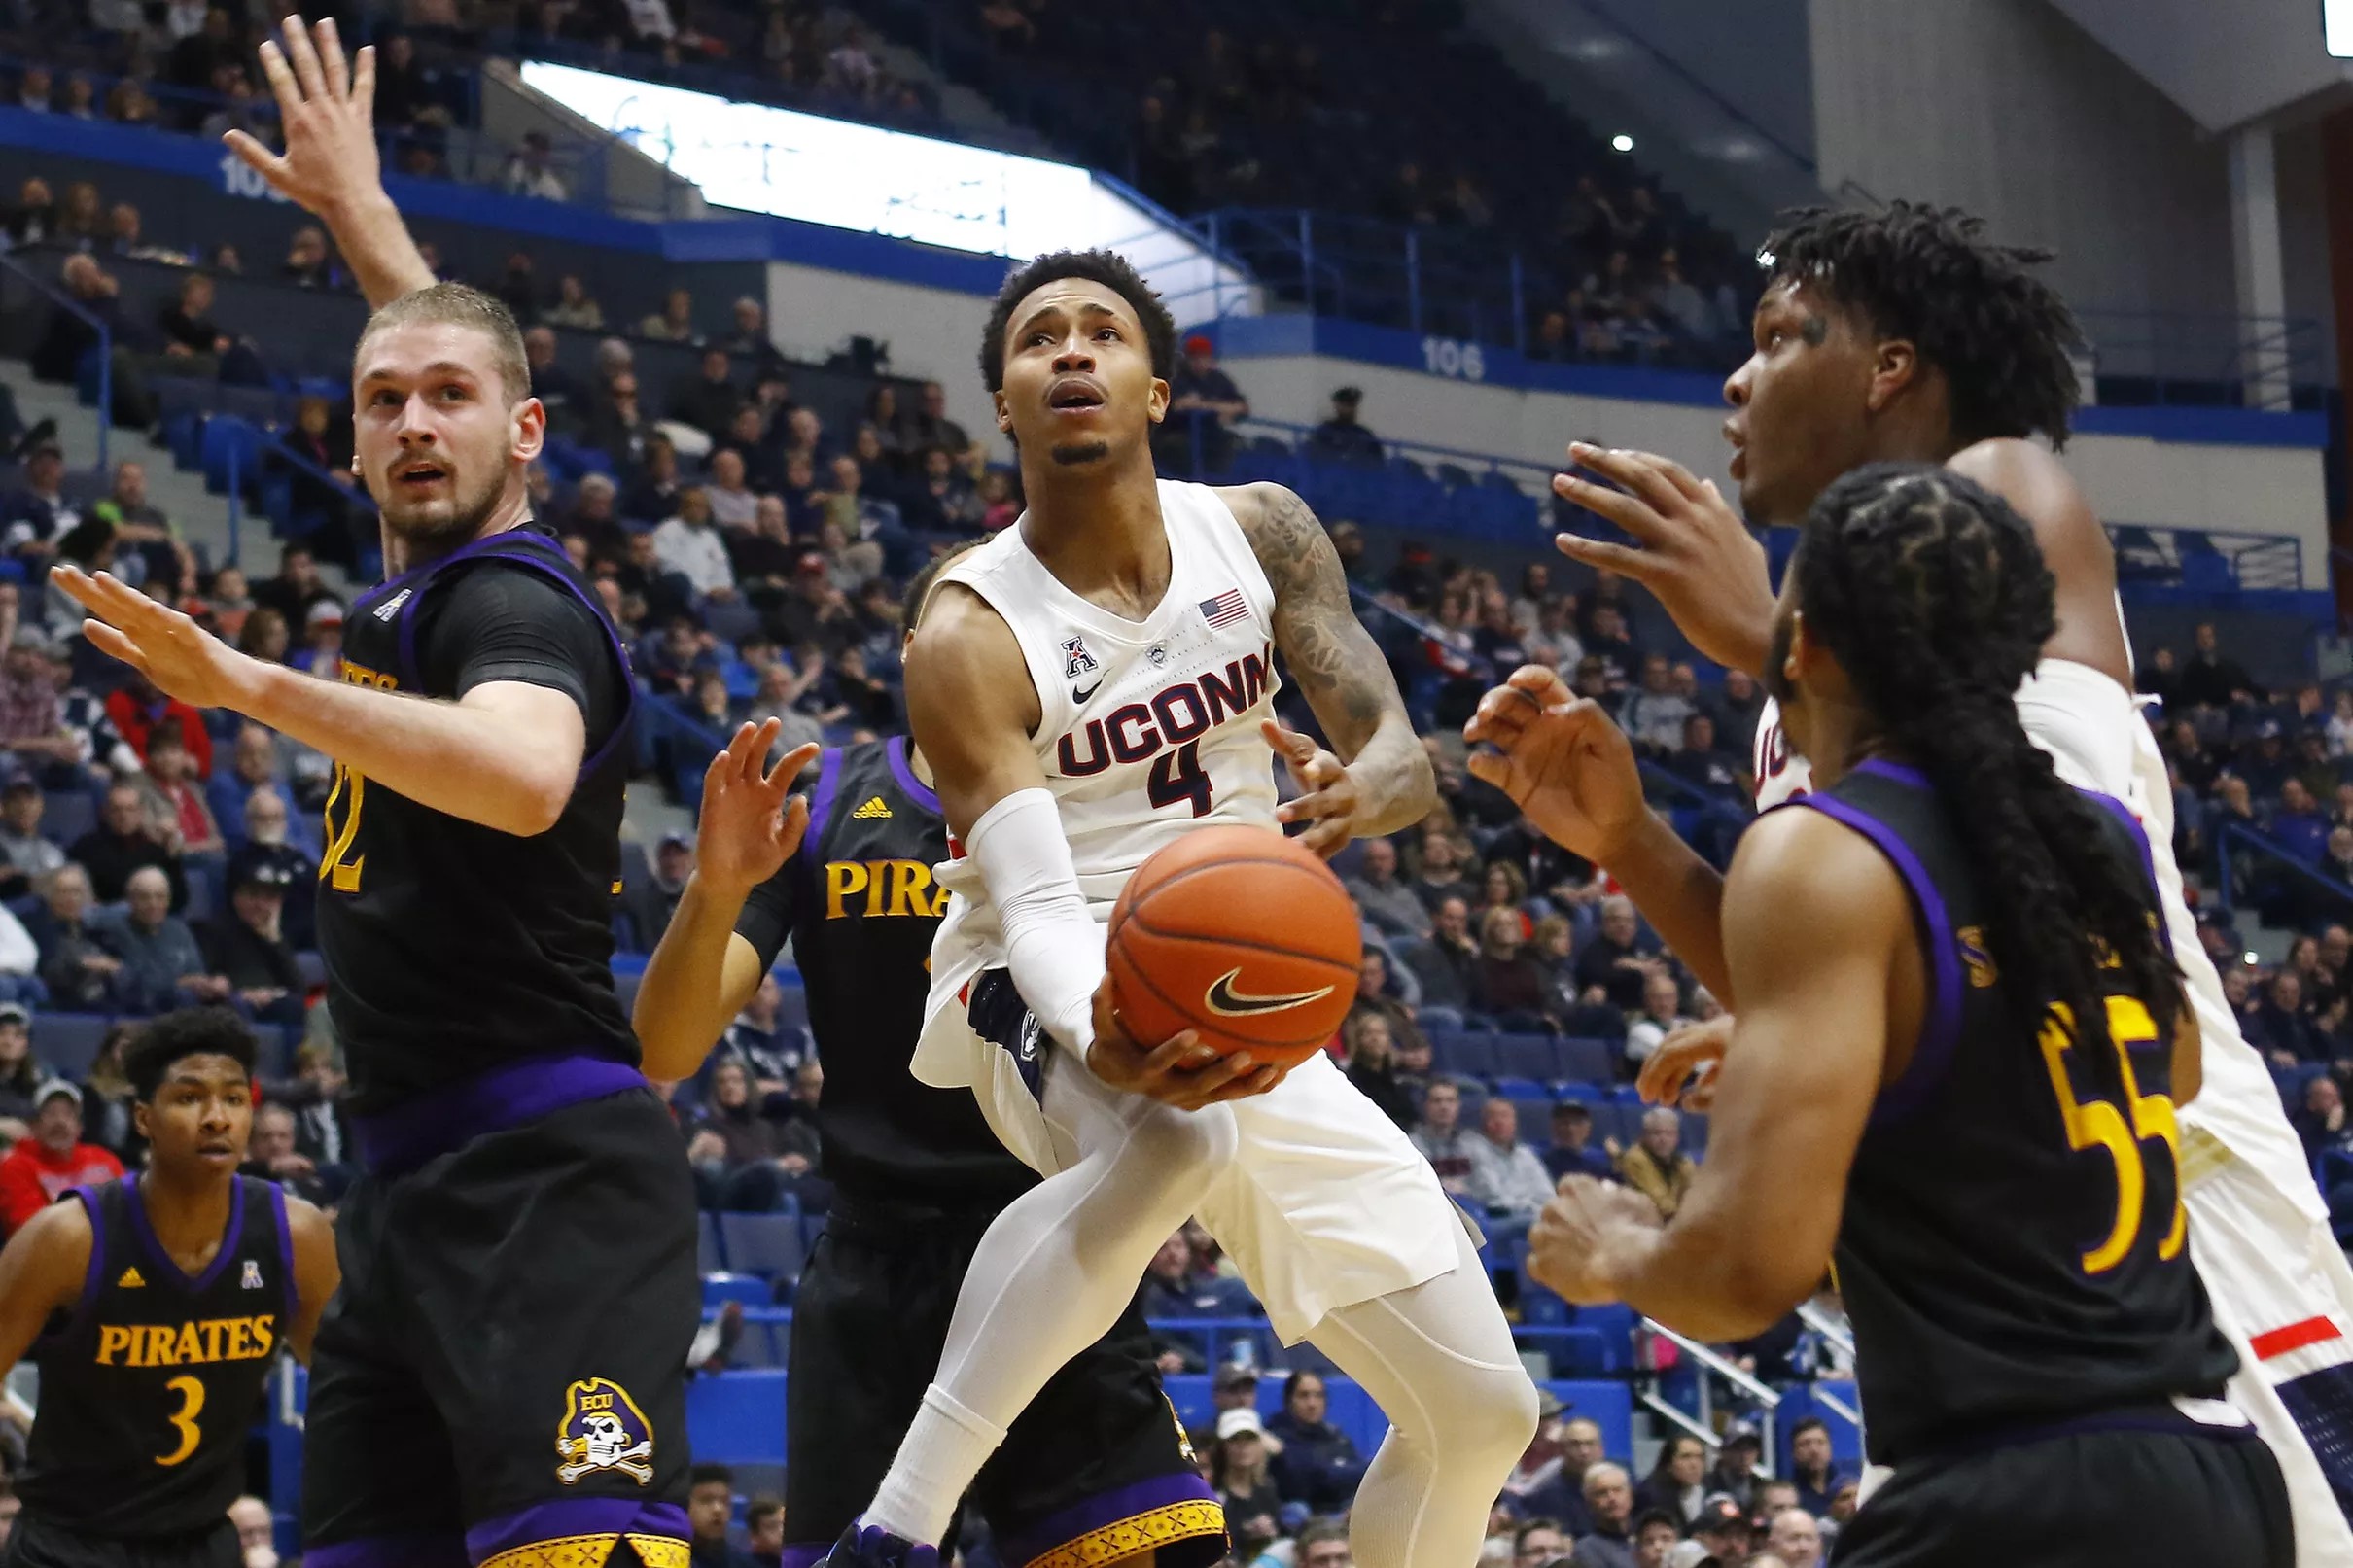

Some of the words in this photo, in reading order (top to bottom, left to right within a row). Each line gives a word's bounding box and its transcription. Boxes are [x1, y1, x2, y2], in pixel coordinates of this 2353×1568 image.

[1422, 337, 1485, 380] 106
[1057, 641, 1271, 777] UCONN
[1147, 736, 1213, 819] 4
[853, 809, 894, 819] adidas
[2038, 993, 2188, 1274] 55
[95, 1314, 275, 1367] PIRATES
[155, 1375, 206, 1466] 3
[580, 1393, 614, 1411] ECU
